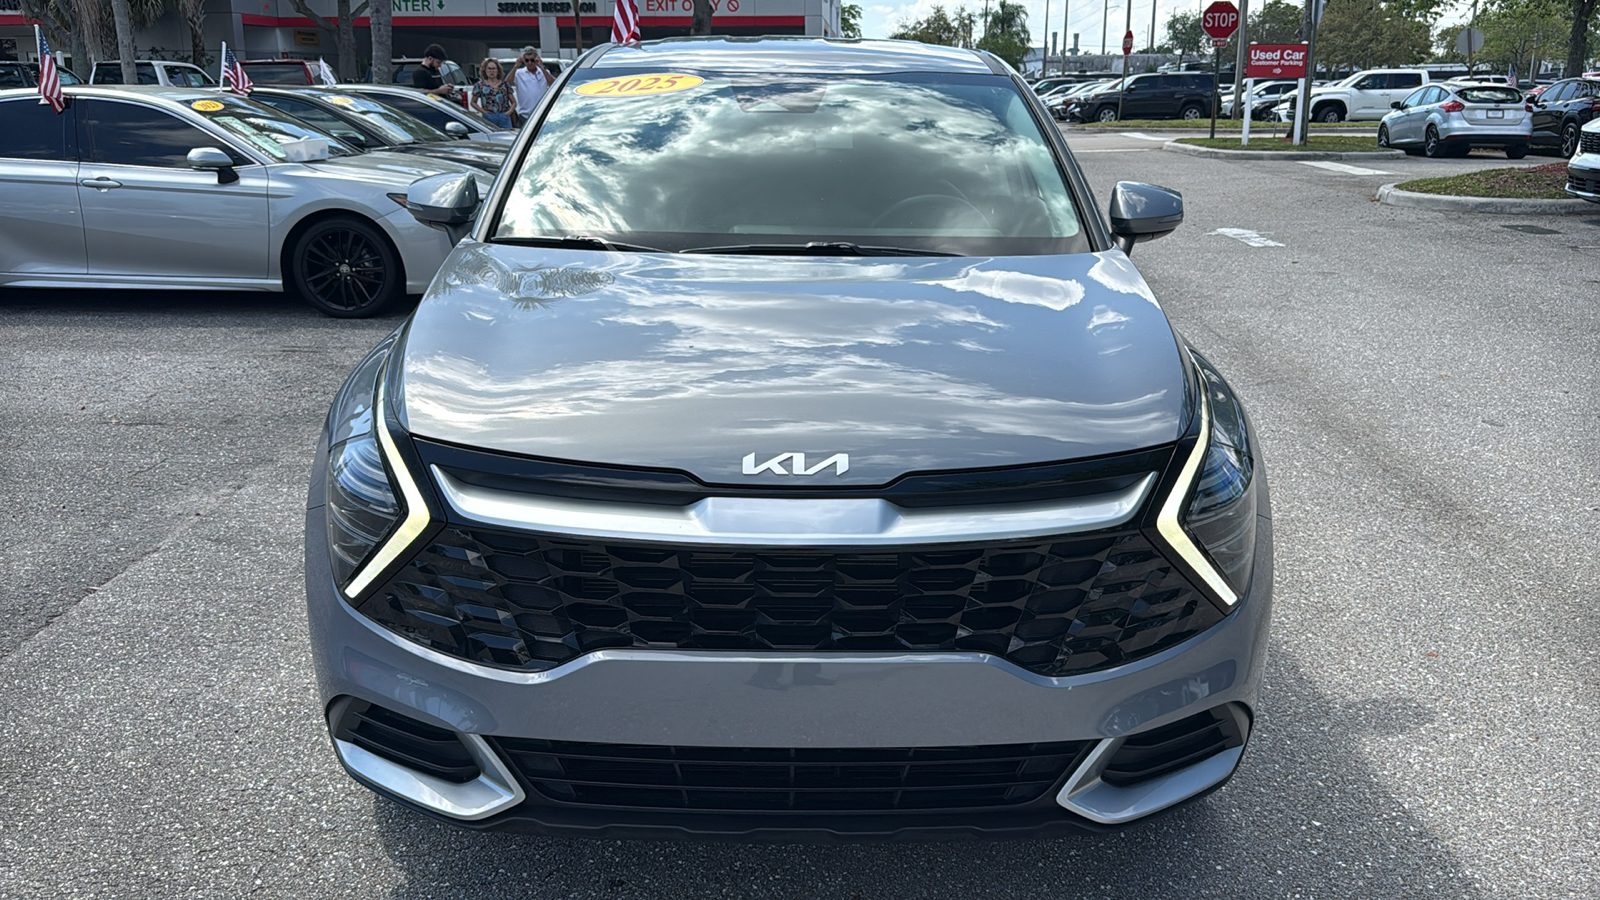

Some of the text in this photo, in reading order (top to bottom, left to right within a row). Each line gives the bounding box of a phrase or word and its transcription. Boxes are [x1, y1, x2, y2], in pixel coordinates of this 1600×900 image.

[392, 0, 432, 12] NTER
[497, 2, 597, 13] SERVICE RECEPION
[646, 0, 721, 12] EXIT OY
[1205, 12, 1237, 28] STOP
[1251, 49, 1306, 60] Used Car
[593, 76, 684, 94] 2025
[742, 452, 849, 477] KIA
